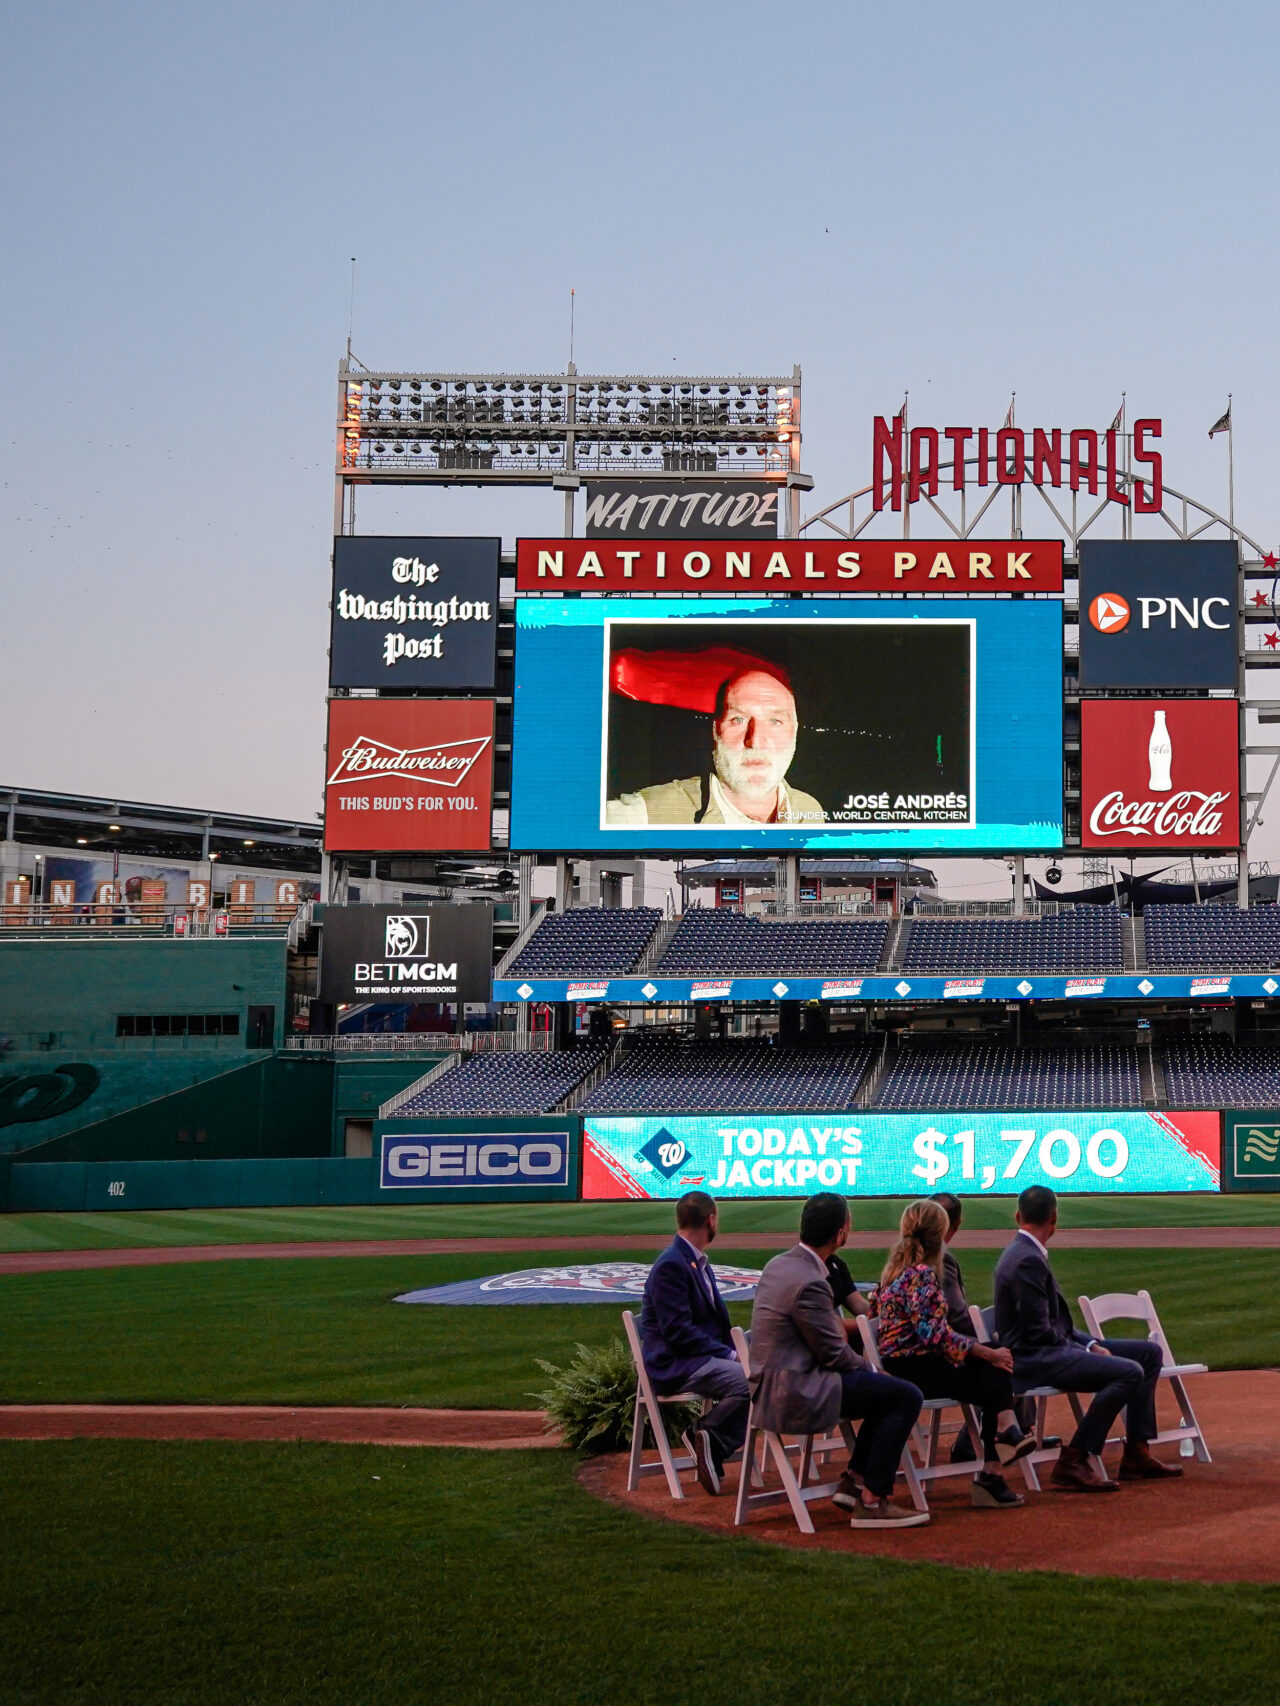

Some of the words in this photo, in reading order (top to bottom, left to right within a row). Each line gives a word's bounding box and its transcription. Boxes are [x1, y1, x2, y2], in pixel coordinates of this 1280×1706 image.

[873, 416, 1162, 514] NATIONALS
[586, 492, 778, 531] NATITUDE
[392, 557, 440, 586] The
[537, 551, 862, 579] NATIONALS
[894, 552, 1033, 579] PARK
[337, 588, 492, 627] Washington
[1138, 597, 1230, 630] PNC
[383, 633, 444, 666] Post
[342, 747, 473, 772] Budweiser
[339, 796, 370, 810] THIS
[373, 796, 414, 810] BUD'S
[417, 796, 444, 810] FOR
[447, 796, 478, 810] YOU.
[843, 792, 890, 809] JOSÉ
[894, 791, 967, 809] ANDRÉS
[1089, 791, 1231, 836] Coca-Cola
[778, 811, 831, 821] FOUNDER,
[833, 811, 872, 820] WORLD
[874, 811, 921, 820] CENTRAL
[923, 810, 967, 820] KITCHEN
[354, 963, 458, 981] BETMGM
[355, 986, 370, 994] THE
[371, 986, 390, 994] KING
[391, 986, 401, 994] OF
[402, 986, 457, 994] SPORTSBOOKS
[718, 1128, 863, 1157] TODAY'S
[388, 1144, 563, 1177] GEICO
[911, 1127, 1130, 1189] $1,700
[708, 1159, 863, 1187] JACKPOT
[108, 1181, 126, 1196] 402
